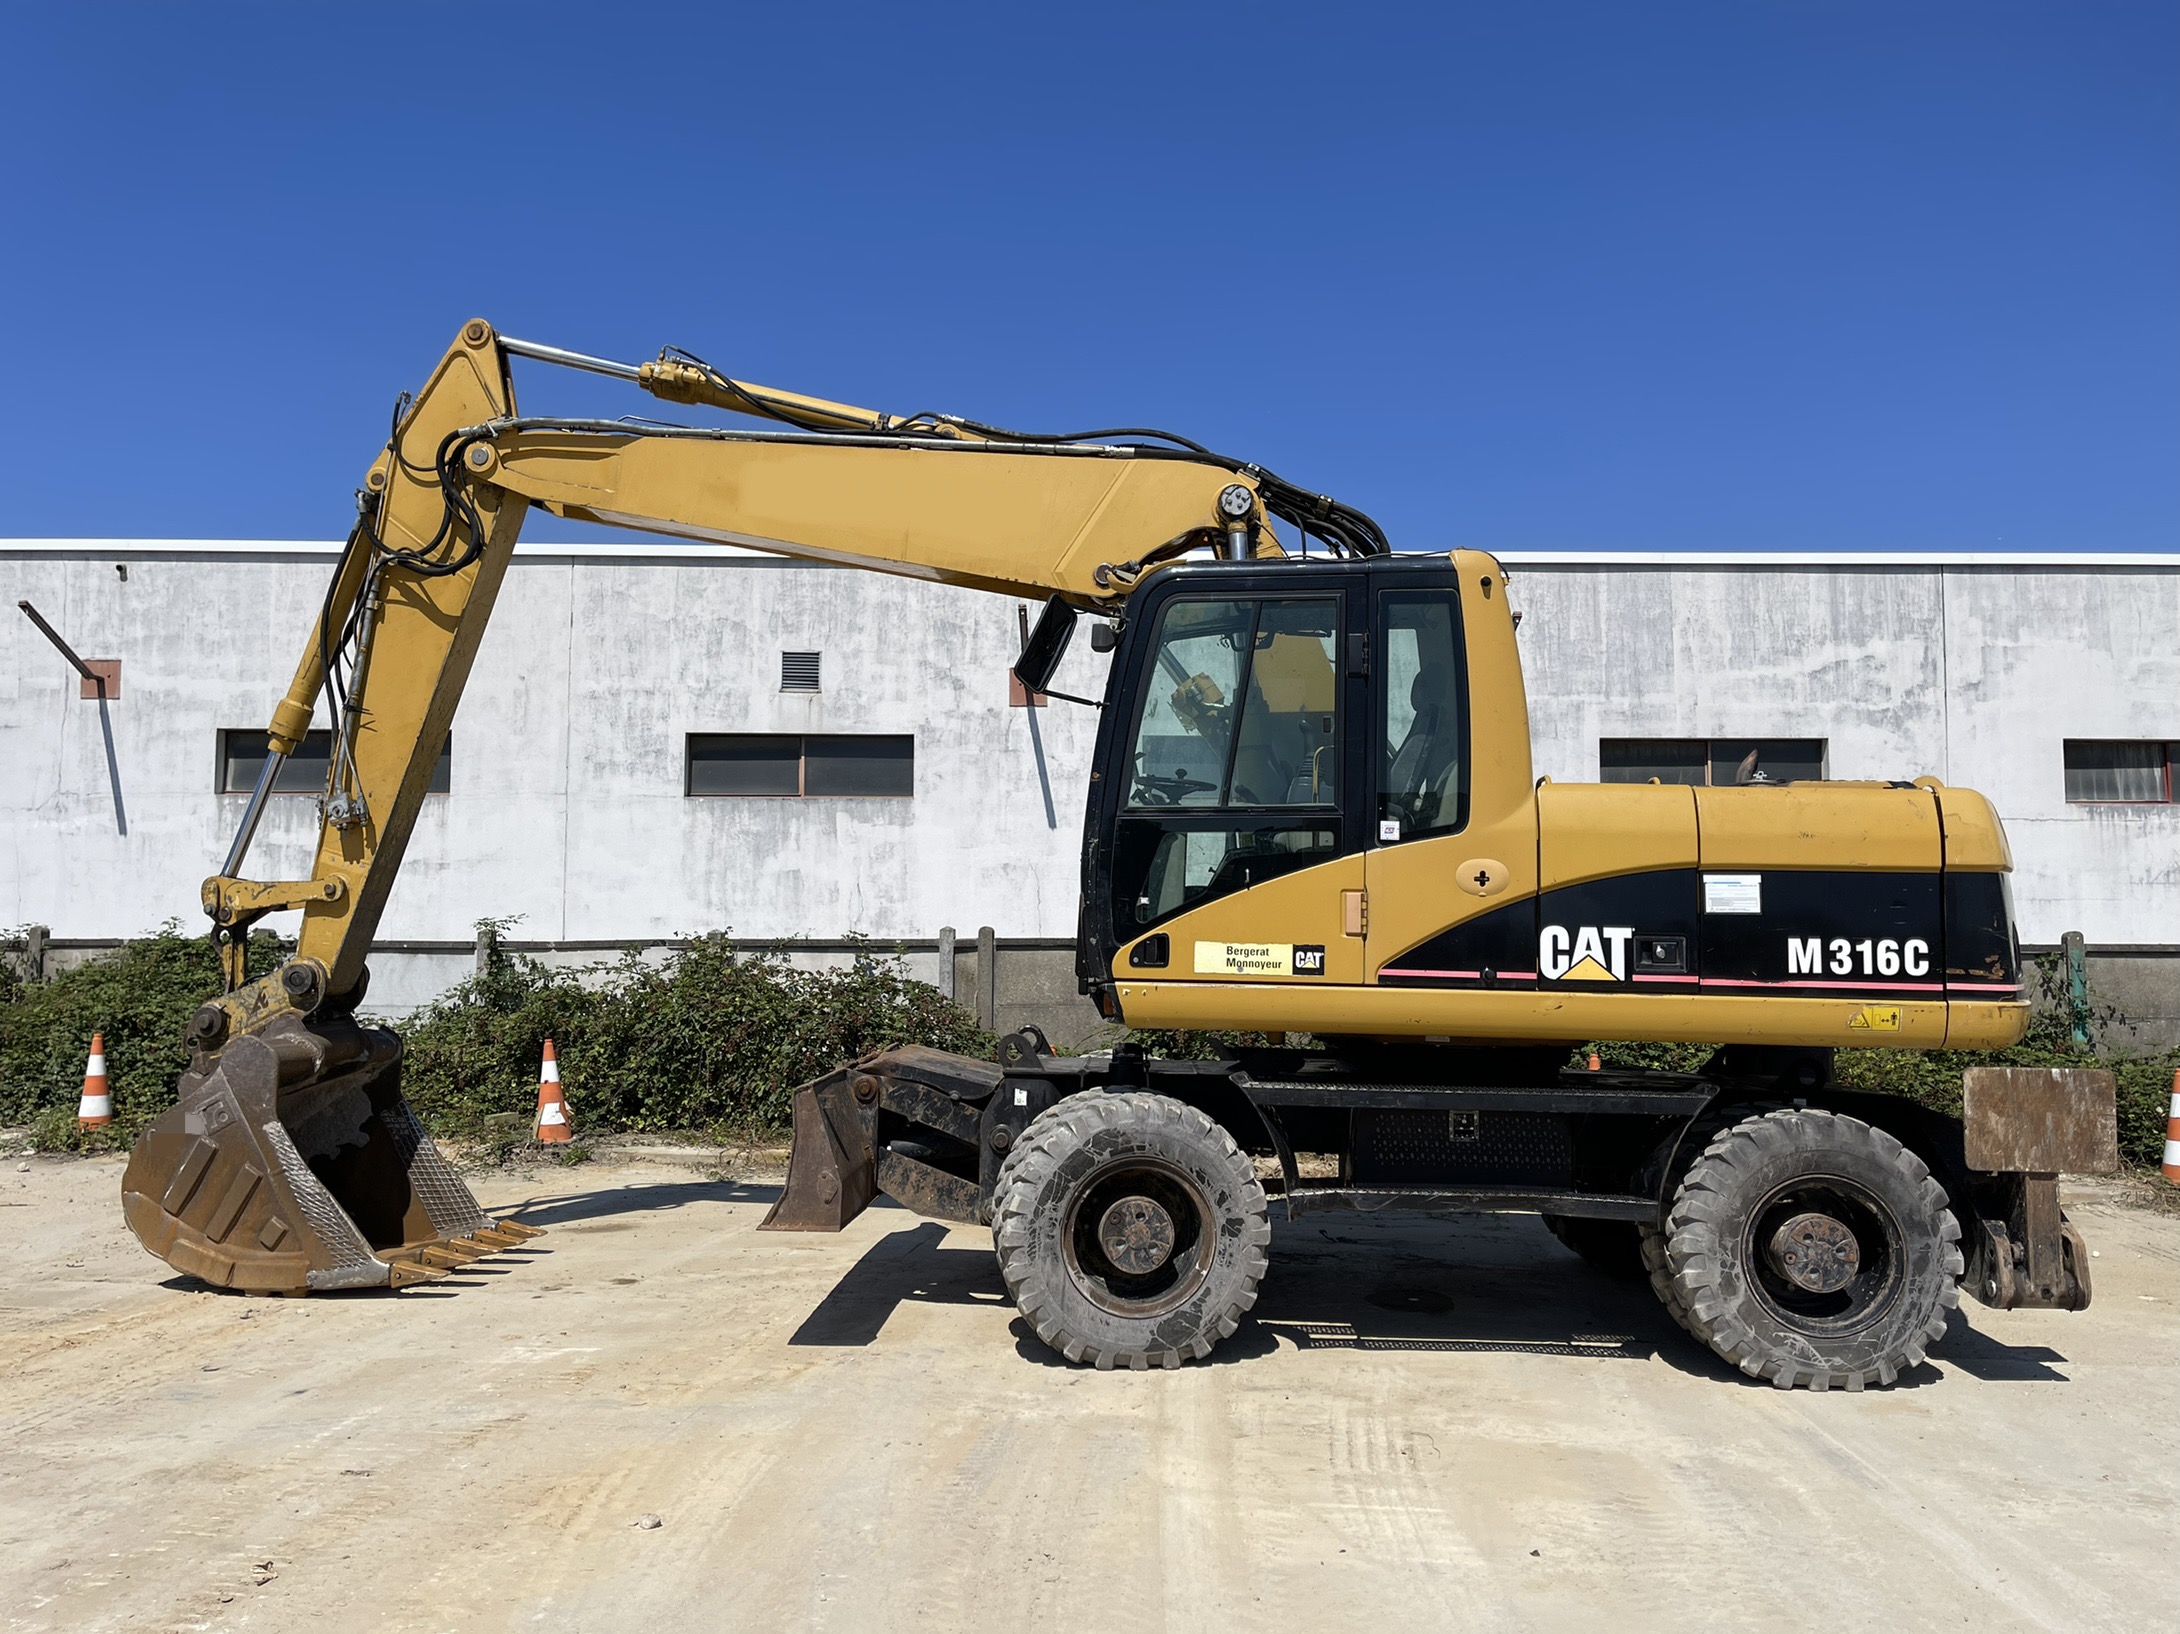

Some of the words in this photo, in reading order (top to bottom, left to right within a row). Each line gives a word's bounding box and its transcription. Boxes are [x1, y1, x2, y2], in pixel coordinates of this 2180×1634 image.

[1226, 946, 1269, 958] Bergerat
[1539, 925, 1633, 981] CAT
[1226, 958, 1282, 970] Monnoyeur
[1295, 951, 1324, 968] CAT
